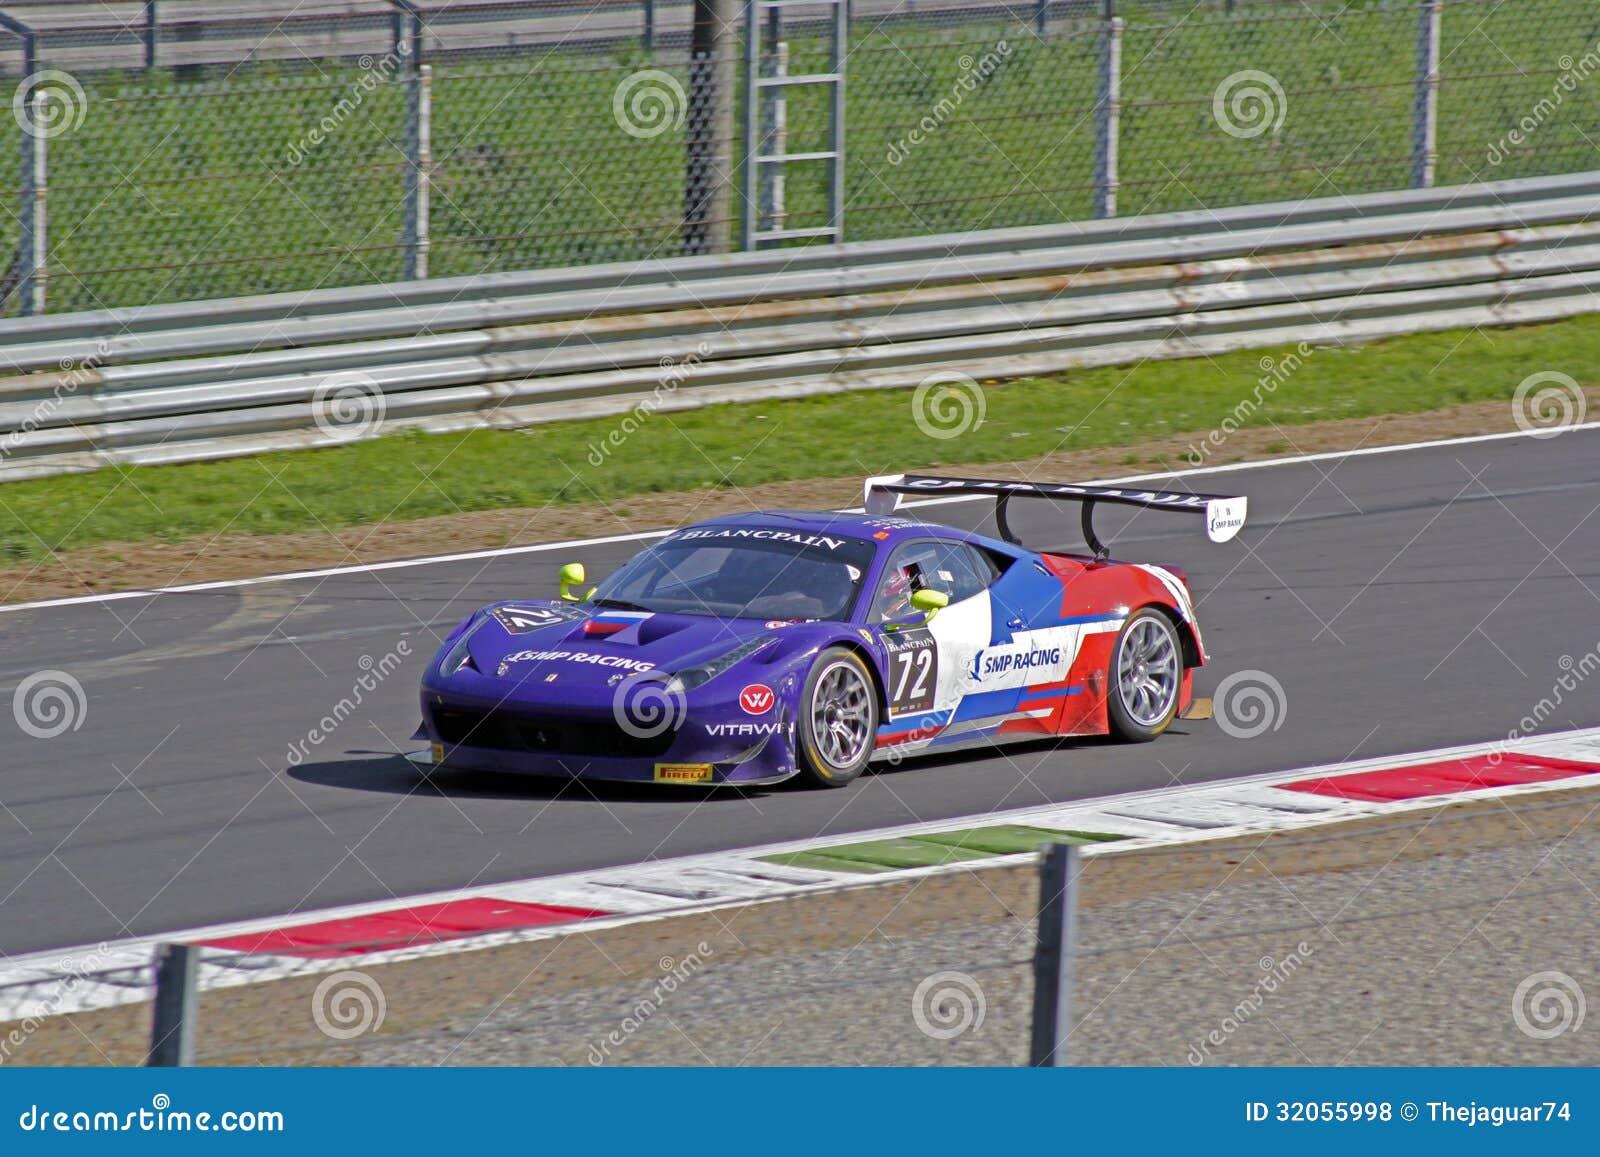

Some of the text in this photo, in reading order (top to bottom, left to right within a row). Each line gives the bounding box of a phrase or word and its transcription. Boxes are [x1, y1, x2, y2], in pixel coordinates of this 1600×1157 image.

[678, 530, 846, 550] BLANCPAIN
[888, 637, 934, 652] BLANCPAIN
[519, 651, 657, 672] SMP RACING
[984, 648, 1060, 674] SMP RACING
[893, 649, 933, 702] 72
